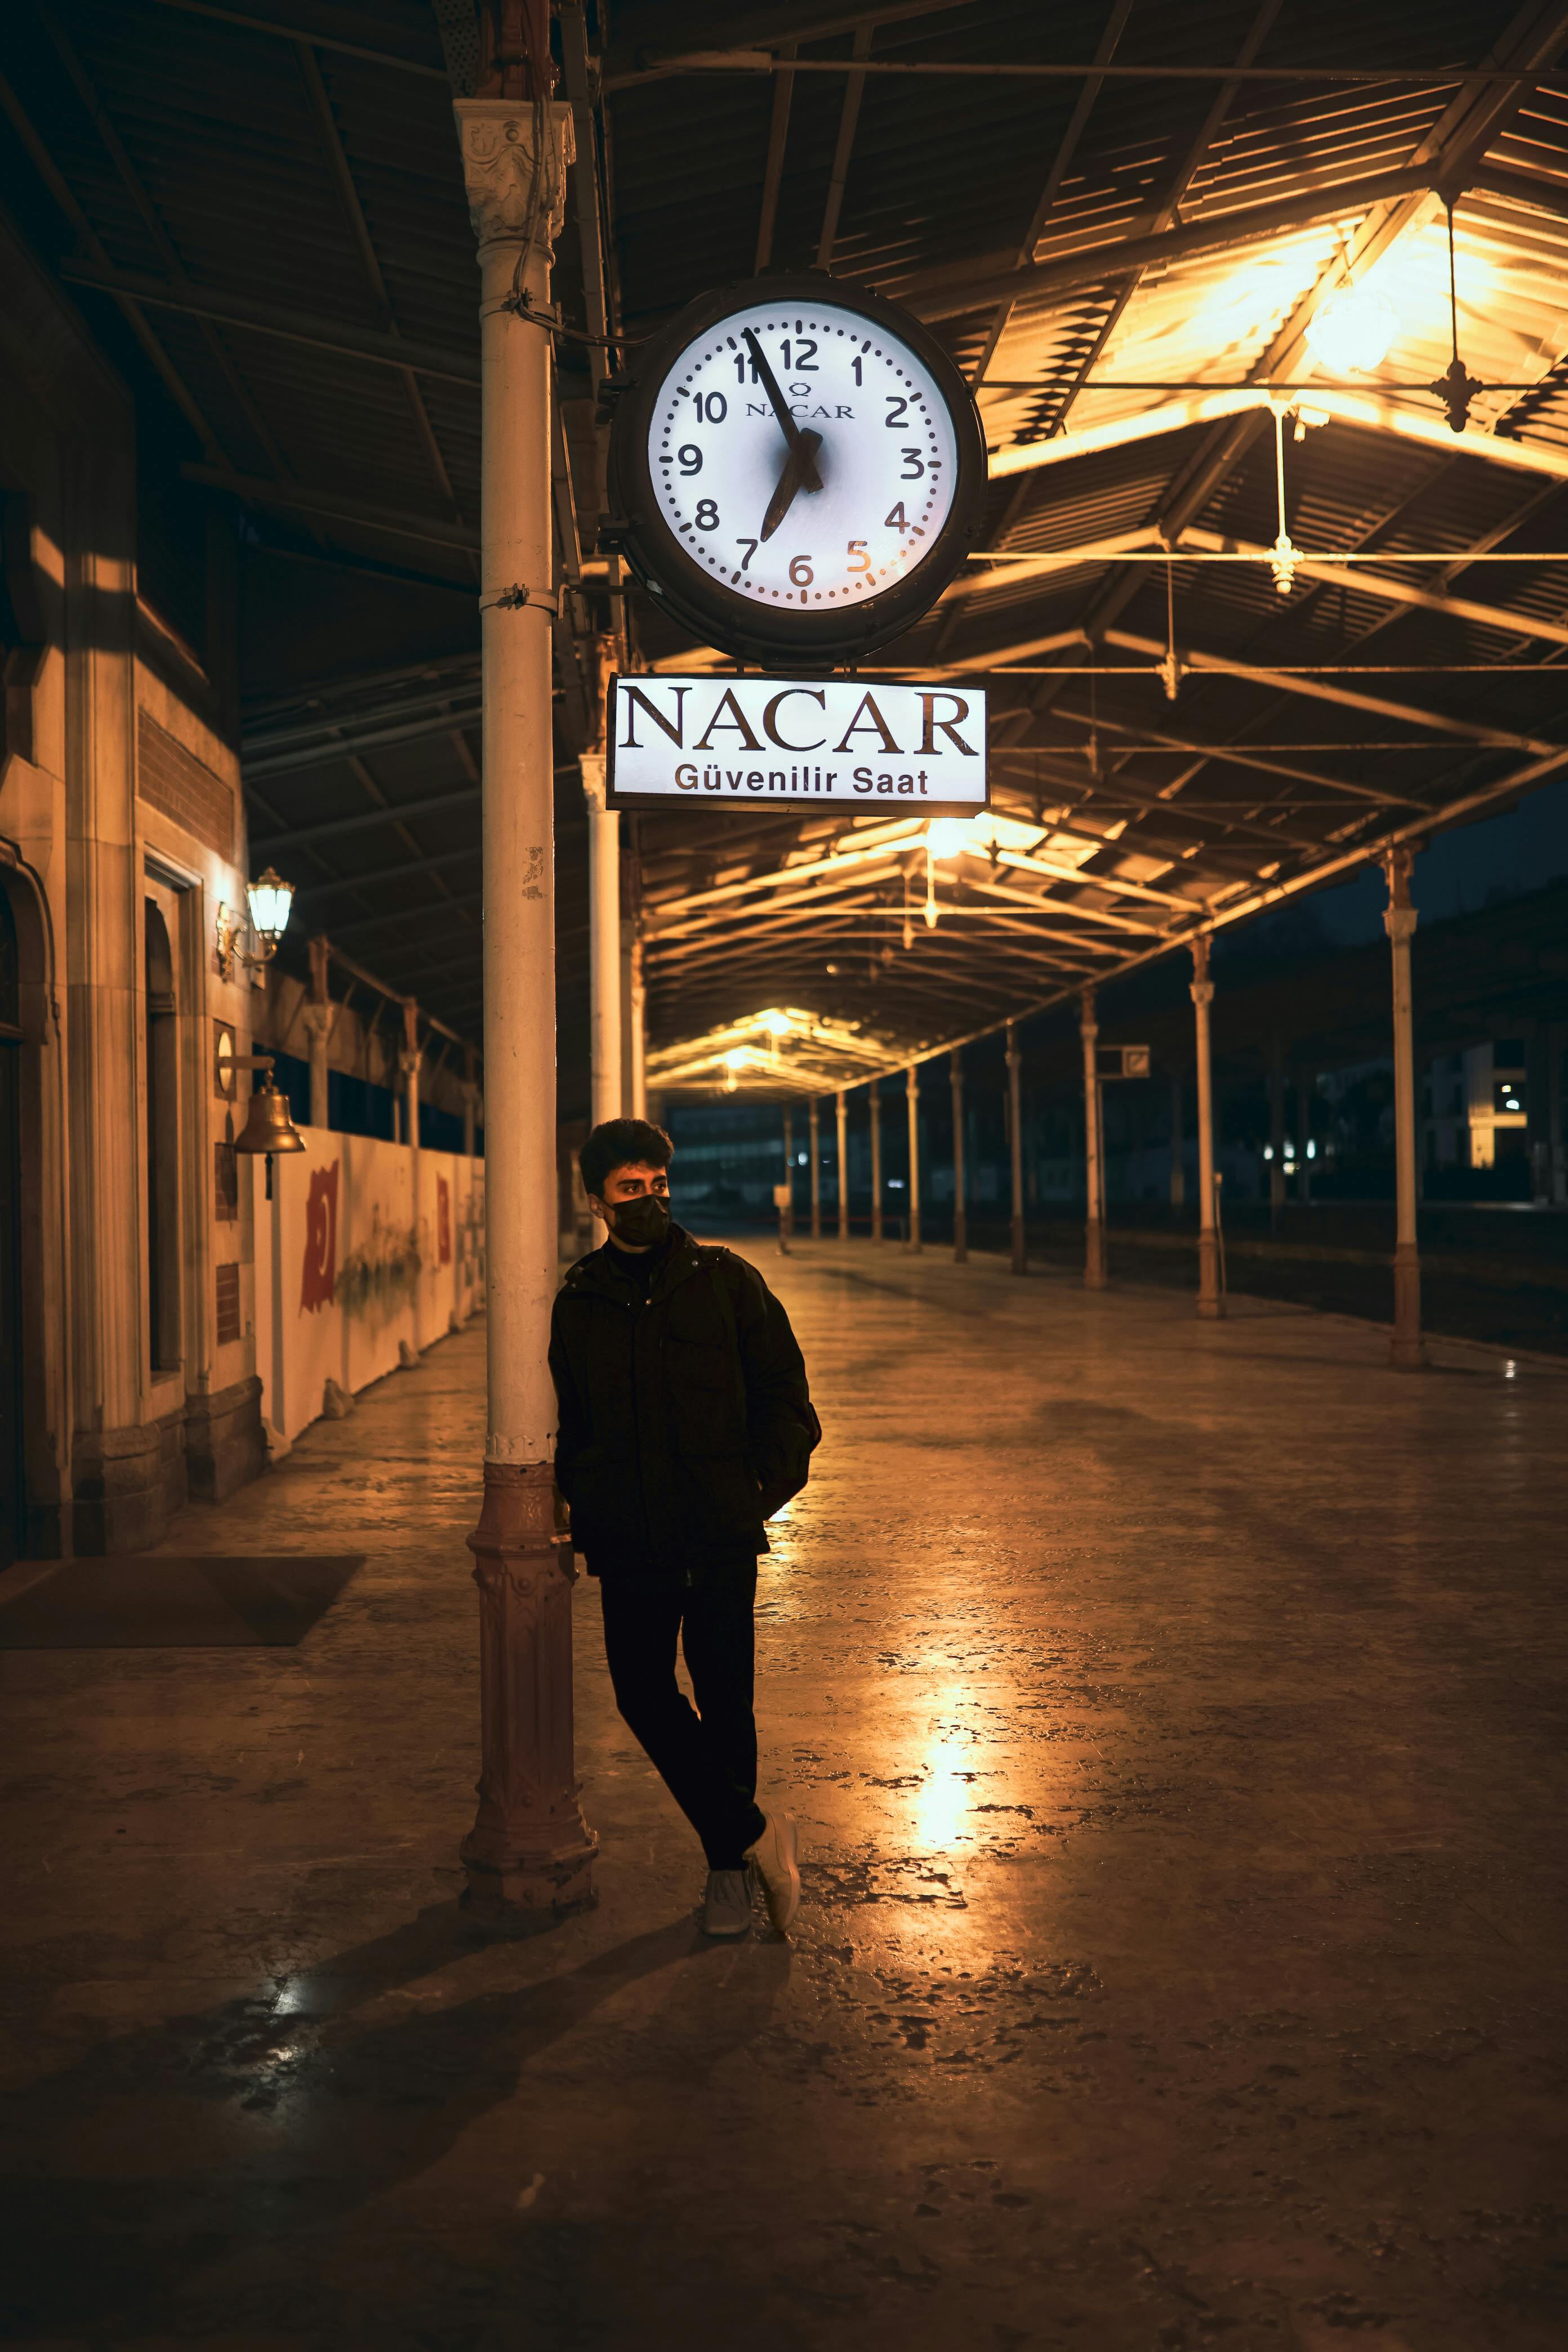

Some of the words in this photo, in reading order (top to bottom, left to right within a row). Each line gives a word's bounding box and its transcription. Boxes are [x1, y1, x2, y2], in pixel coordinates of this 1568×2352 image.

[733, 353, 759, 385] 11
[779, 338, 819, 371] 12
[851, 355, 862, 387] 1
[692, 391, 728, 424] 10
[745, 403, 856, 419] NCAR
[885, 396, 910, 429] 2
[678, 444, 703, 476] 9
[900, 448, 925, 480] 3
[694, 498, 720, 532] 8
[884, 501, 911, 534] 4
[736, 538, 759, 571] 7
[847, 540, 871, 572] 5
[789, 555, 814, 587] 6
[618, 685, 980, 756] NACAR
[675, 764, 838, 792] Güvenilir
[853, 767, 928, 795] Saat
